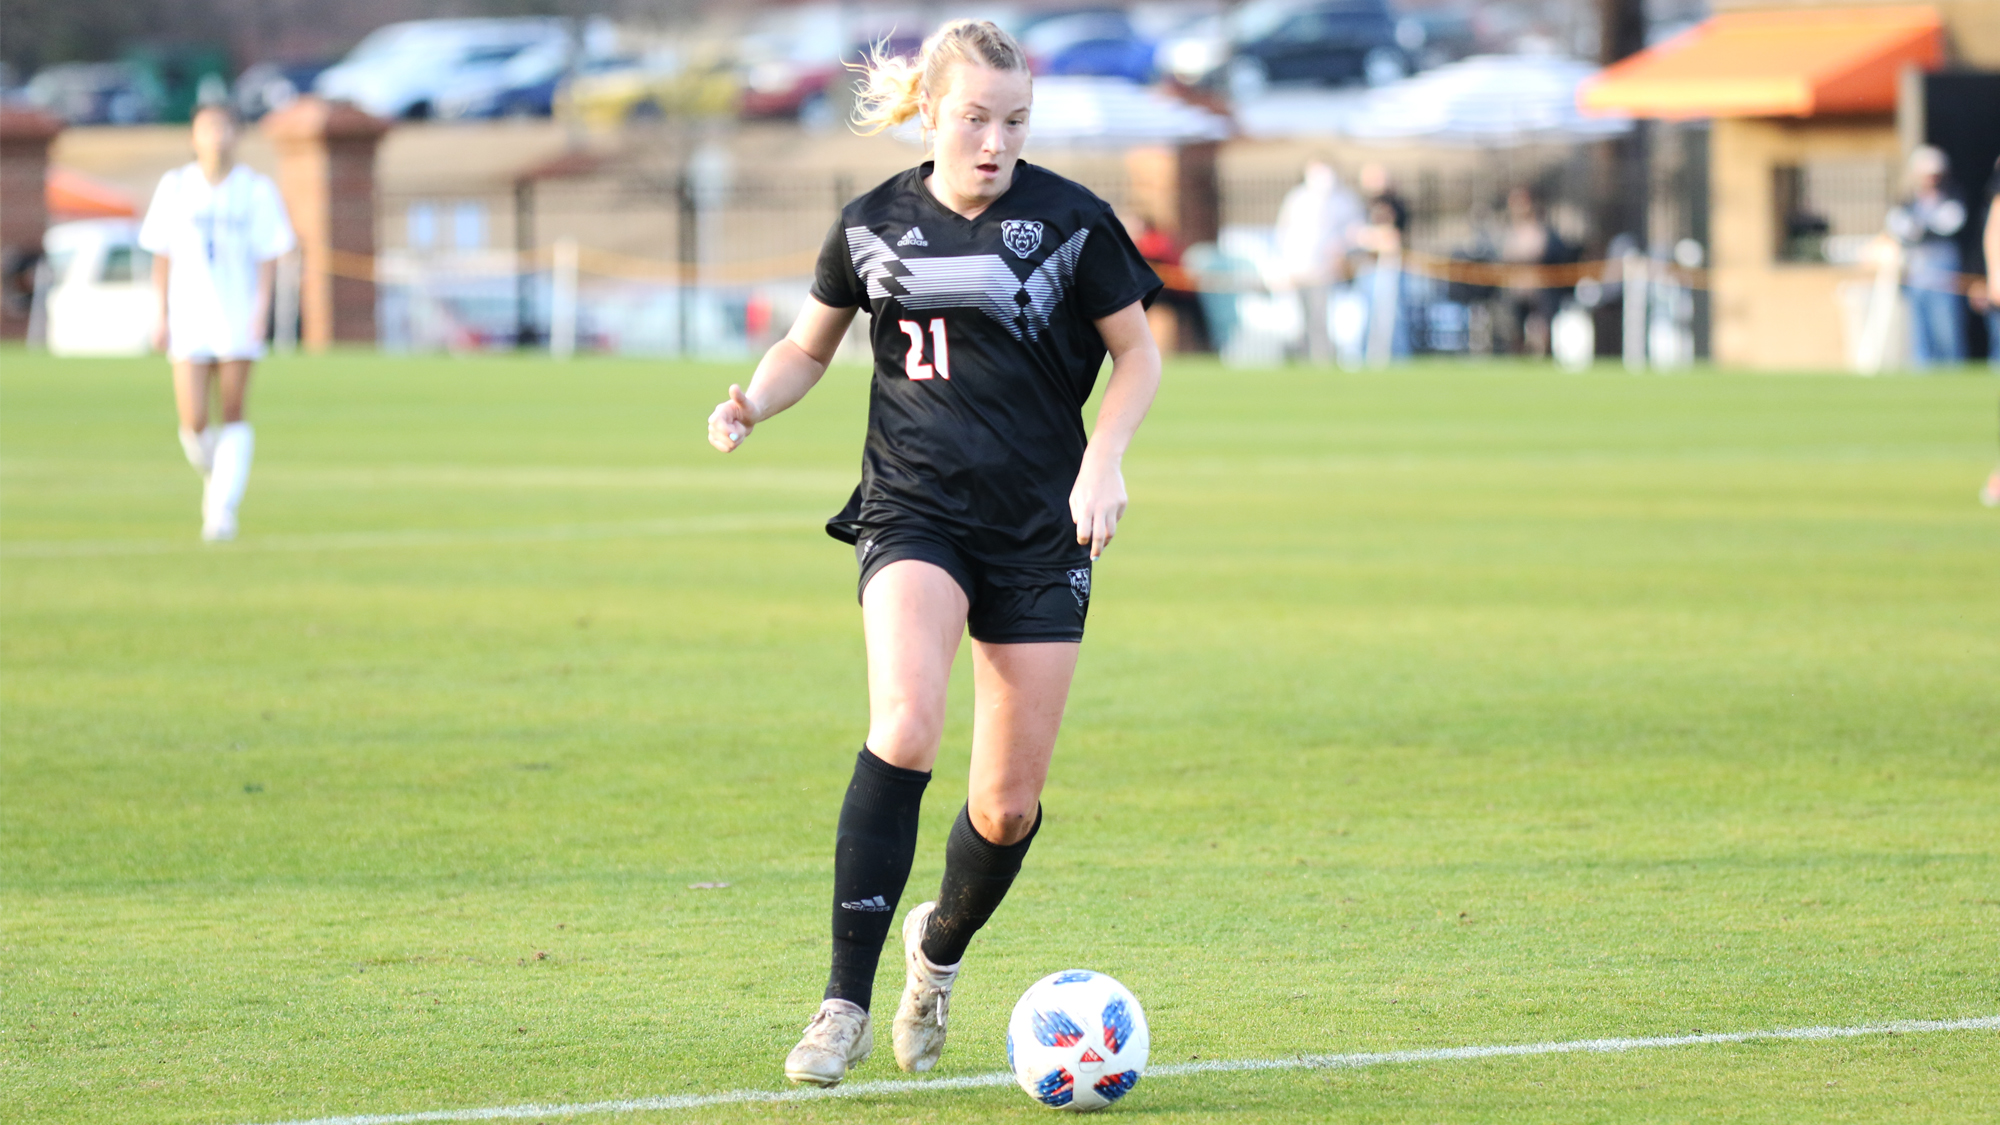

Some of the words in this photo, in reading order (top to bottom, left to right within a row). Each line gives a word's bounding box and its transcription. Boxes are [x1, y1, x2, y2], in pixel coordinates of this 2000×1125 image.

[897, 238, 928, 247] adidas
[898, 317, 950, 381] 21
[841, 902, 891, 912] adidas
